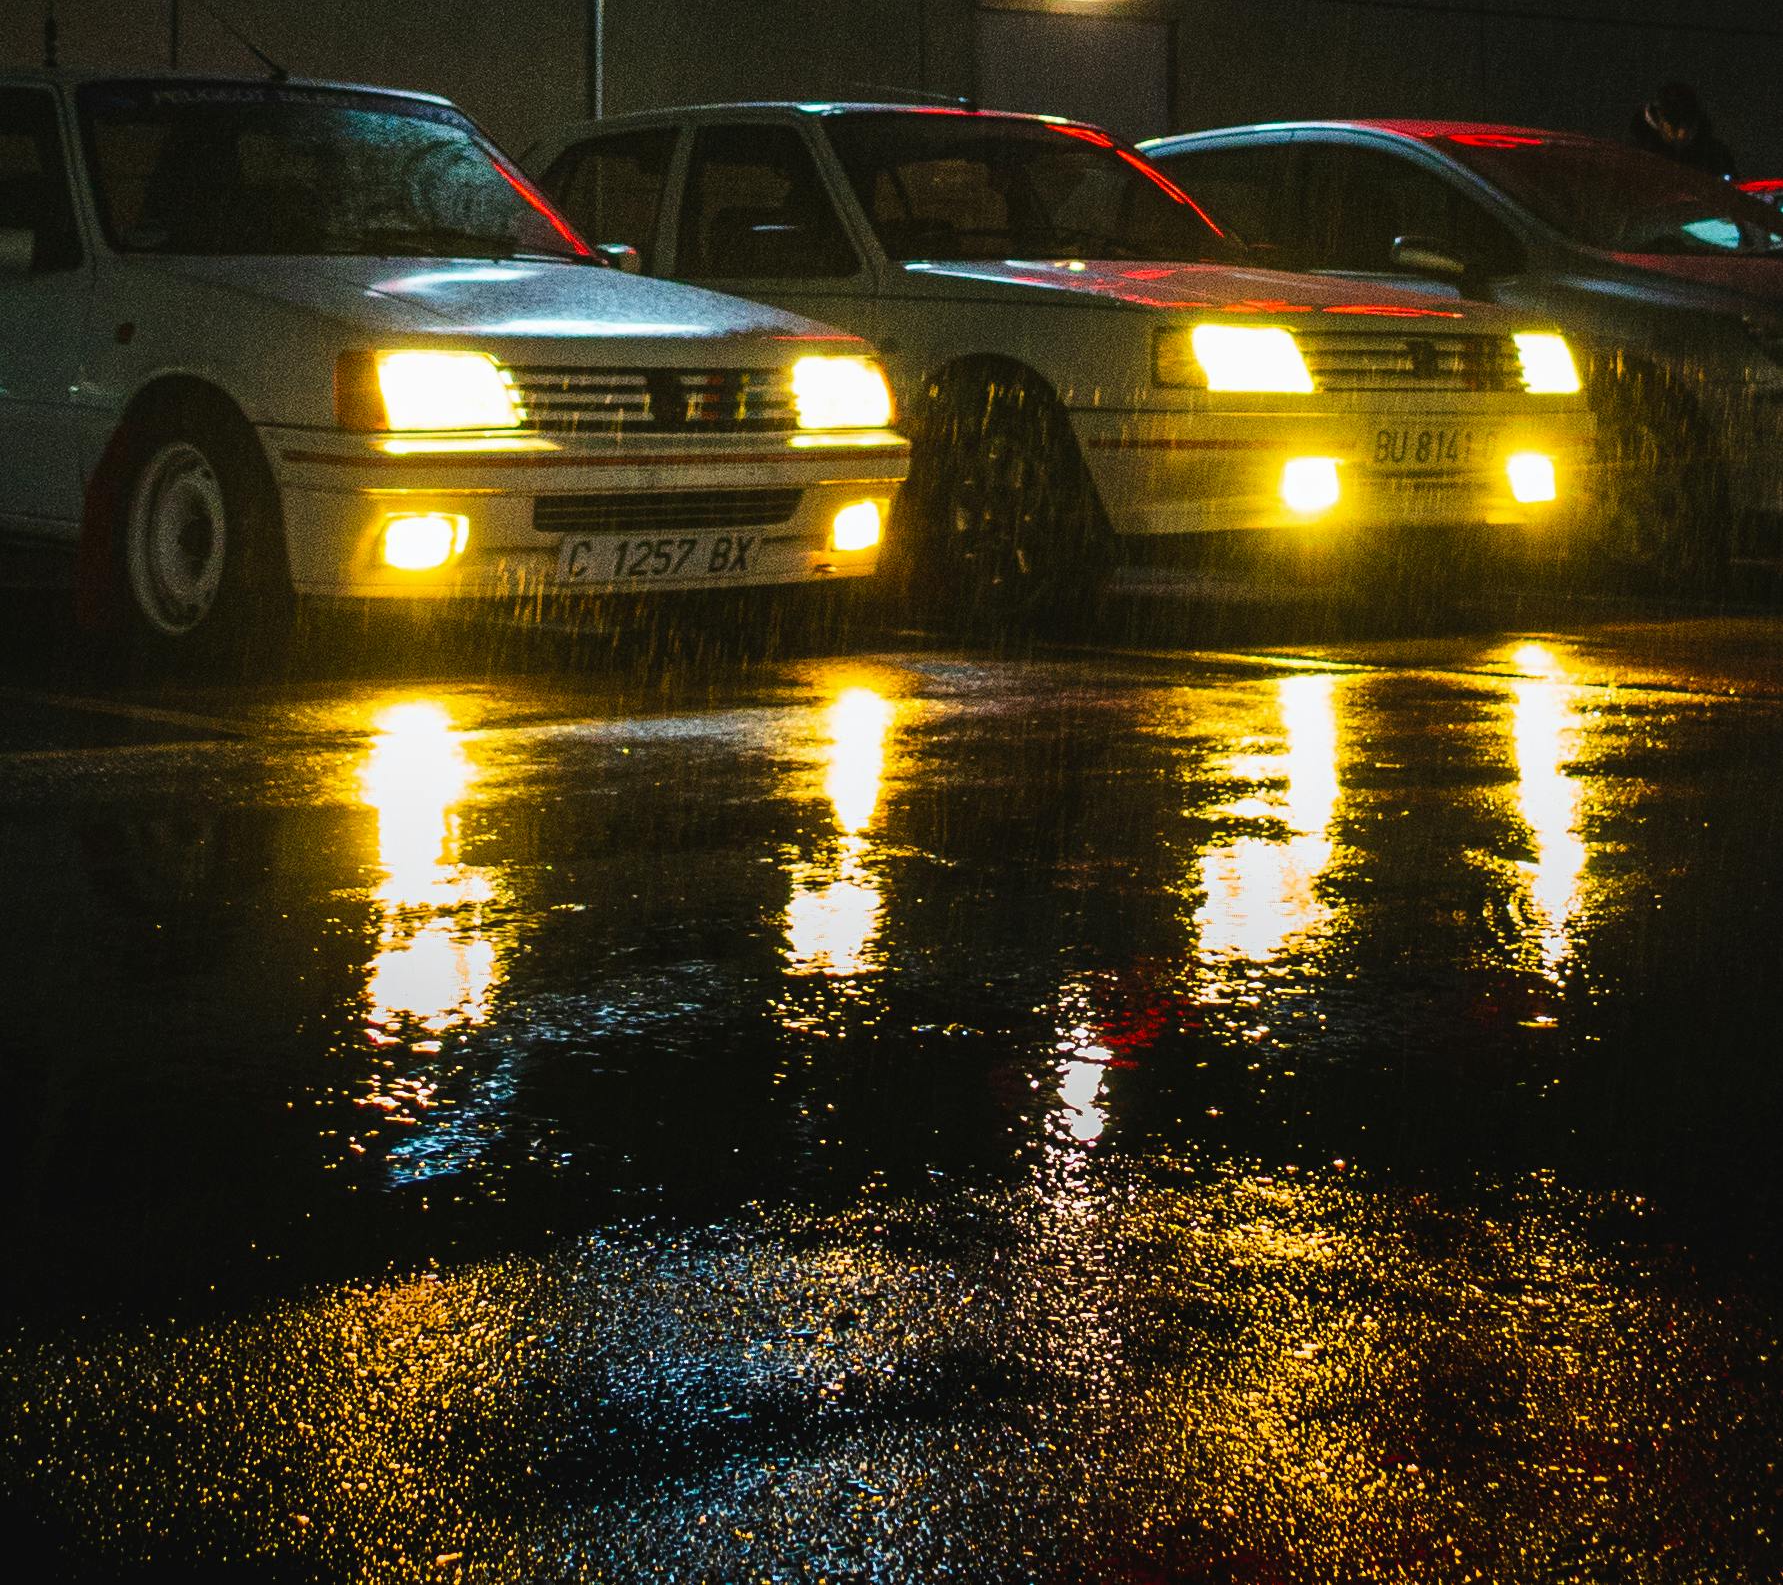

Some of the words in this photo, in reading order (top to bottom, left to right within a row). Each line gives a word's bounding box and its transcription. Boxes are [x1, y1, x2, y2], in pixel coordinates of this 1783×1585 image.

[1374, 429, 1408, 463] BU
[567, 540, 592, 578] C
[613, 538, 698, 578] 1257
[707, 536, 753, 574] BX
